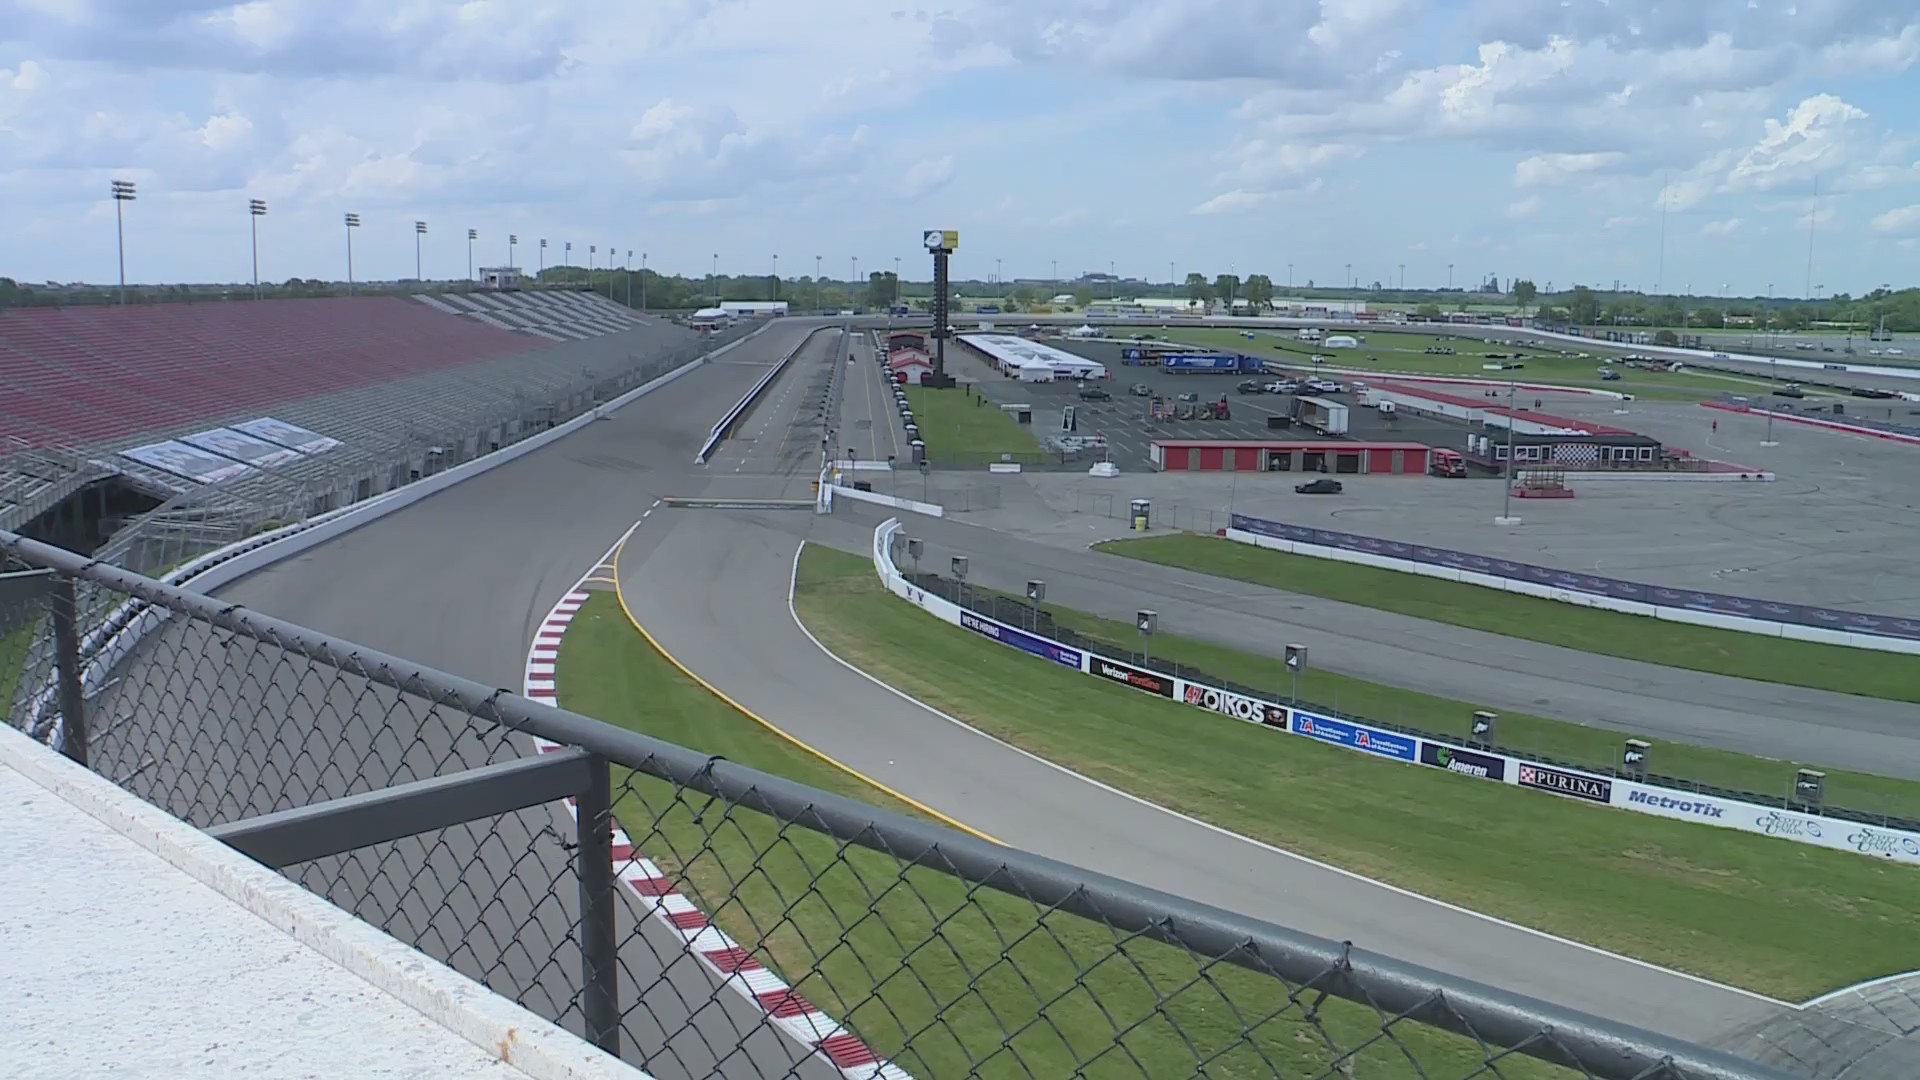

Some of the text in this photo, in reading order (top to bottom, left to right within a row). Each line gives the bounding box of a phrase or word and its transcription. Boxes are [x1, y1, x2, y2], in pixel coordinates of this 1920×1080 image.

[1101, 663, 1128, 681] Verizon
[1185, 685, 1265, 723] 47 OIKOS
[1299, 716, 1315, 735] TA
[1354, 729, 1370, 748] TA
[1447, 758, 1488, 778] Ameren
[1536, 771, 1601, 796] PURINA
[1628, 790, 1725, 818] MetroTix
